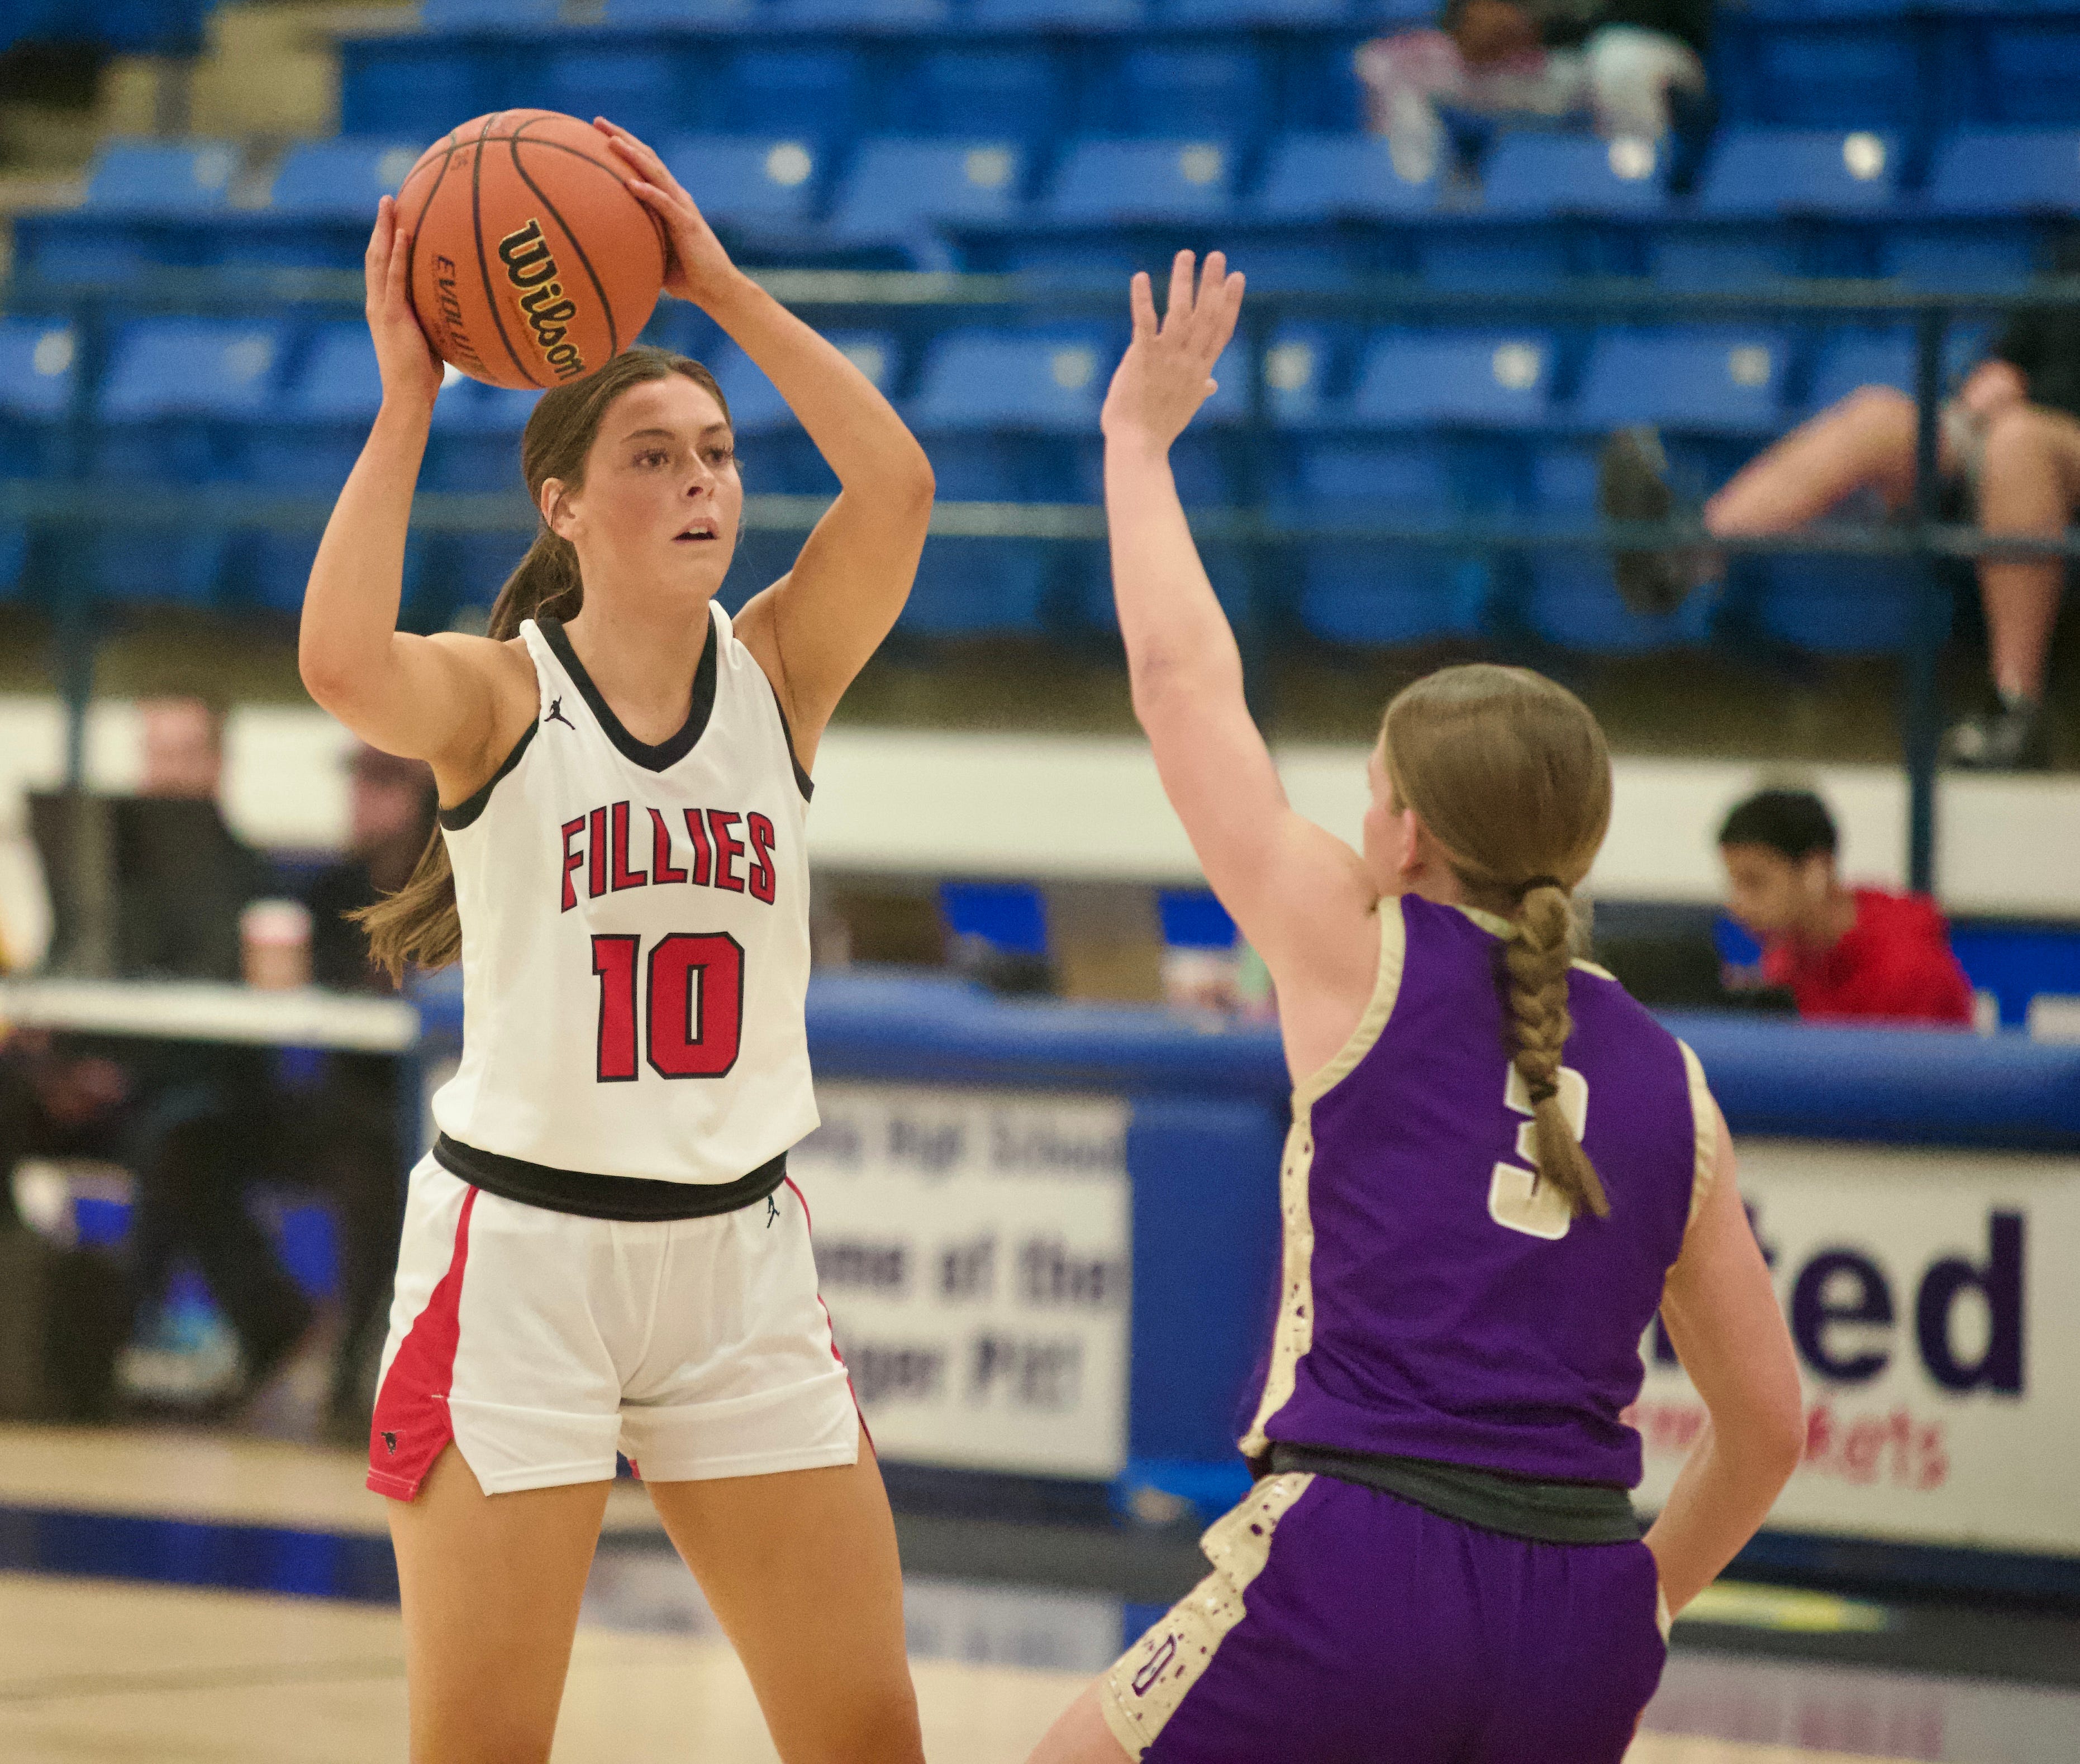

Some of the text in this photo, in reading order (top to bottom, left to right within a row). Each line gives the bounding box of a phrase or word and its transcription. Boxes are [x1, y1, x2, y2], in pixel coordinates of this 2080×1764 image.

[497, 218, 587, 381] Wilson
[560, 800, 776, 914] FILLIES
[590, 931, 745, 1083] 10
[1487, 1060, 1589, 1241] 3
